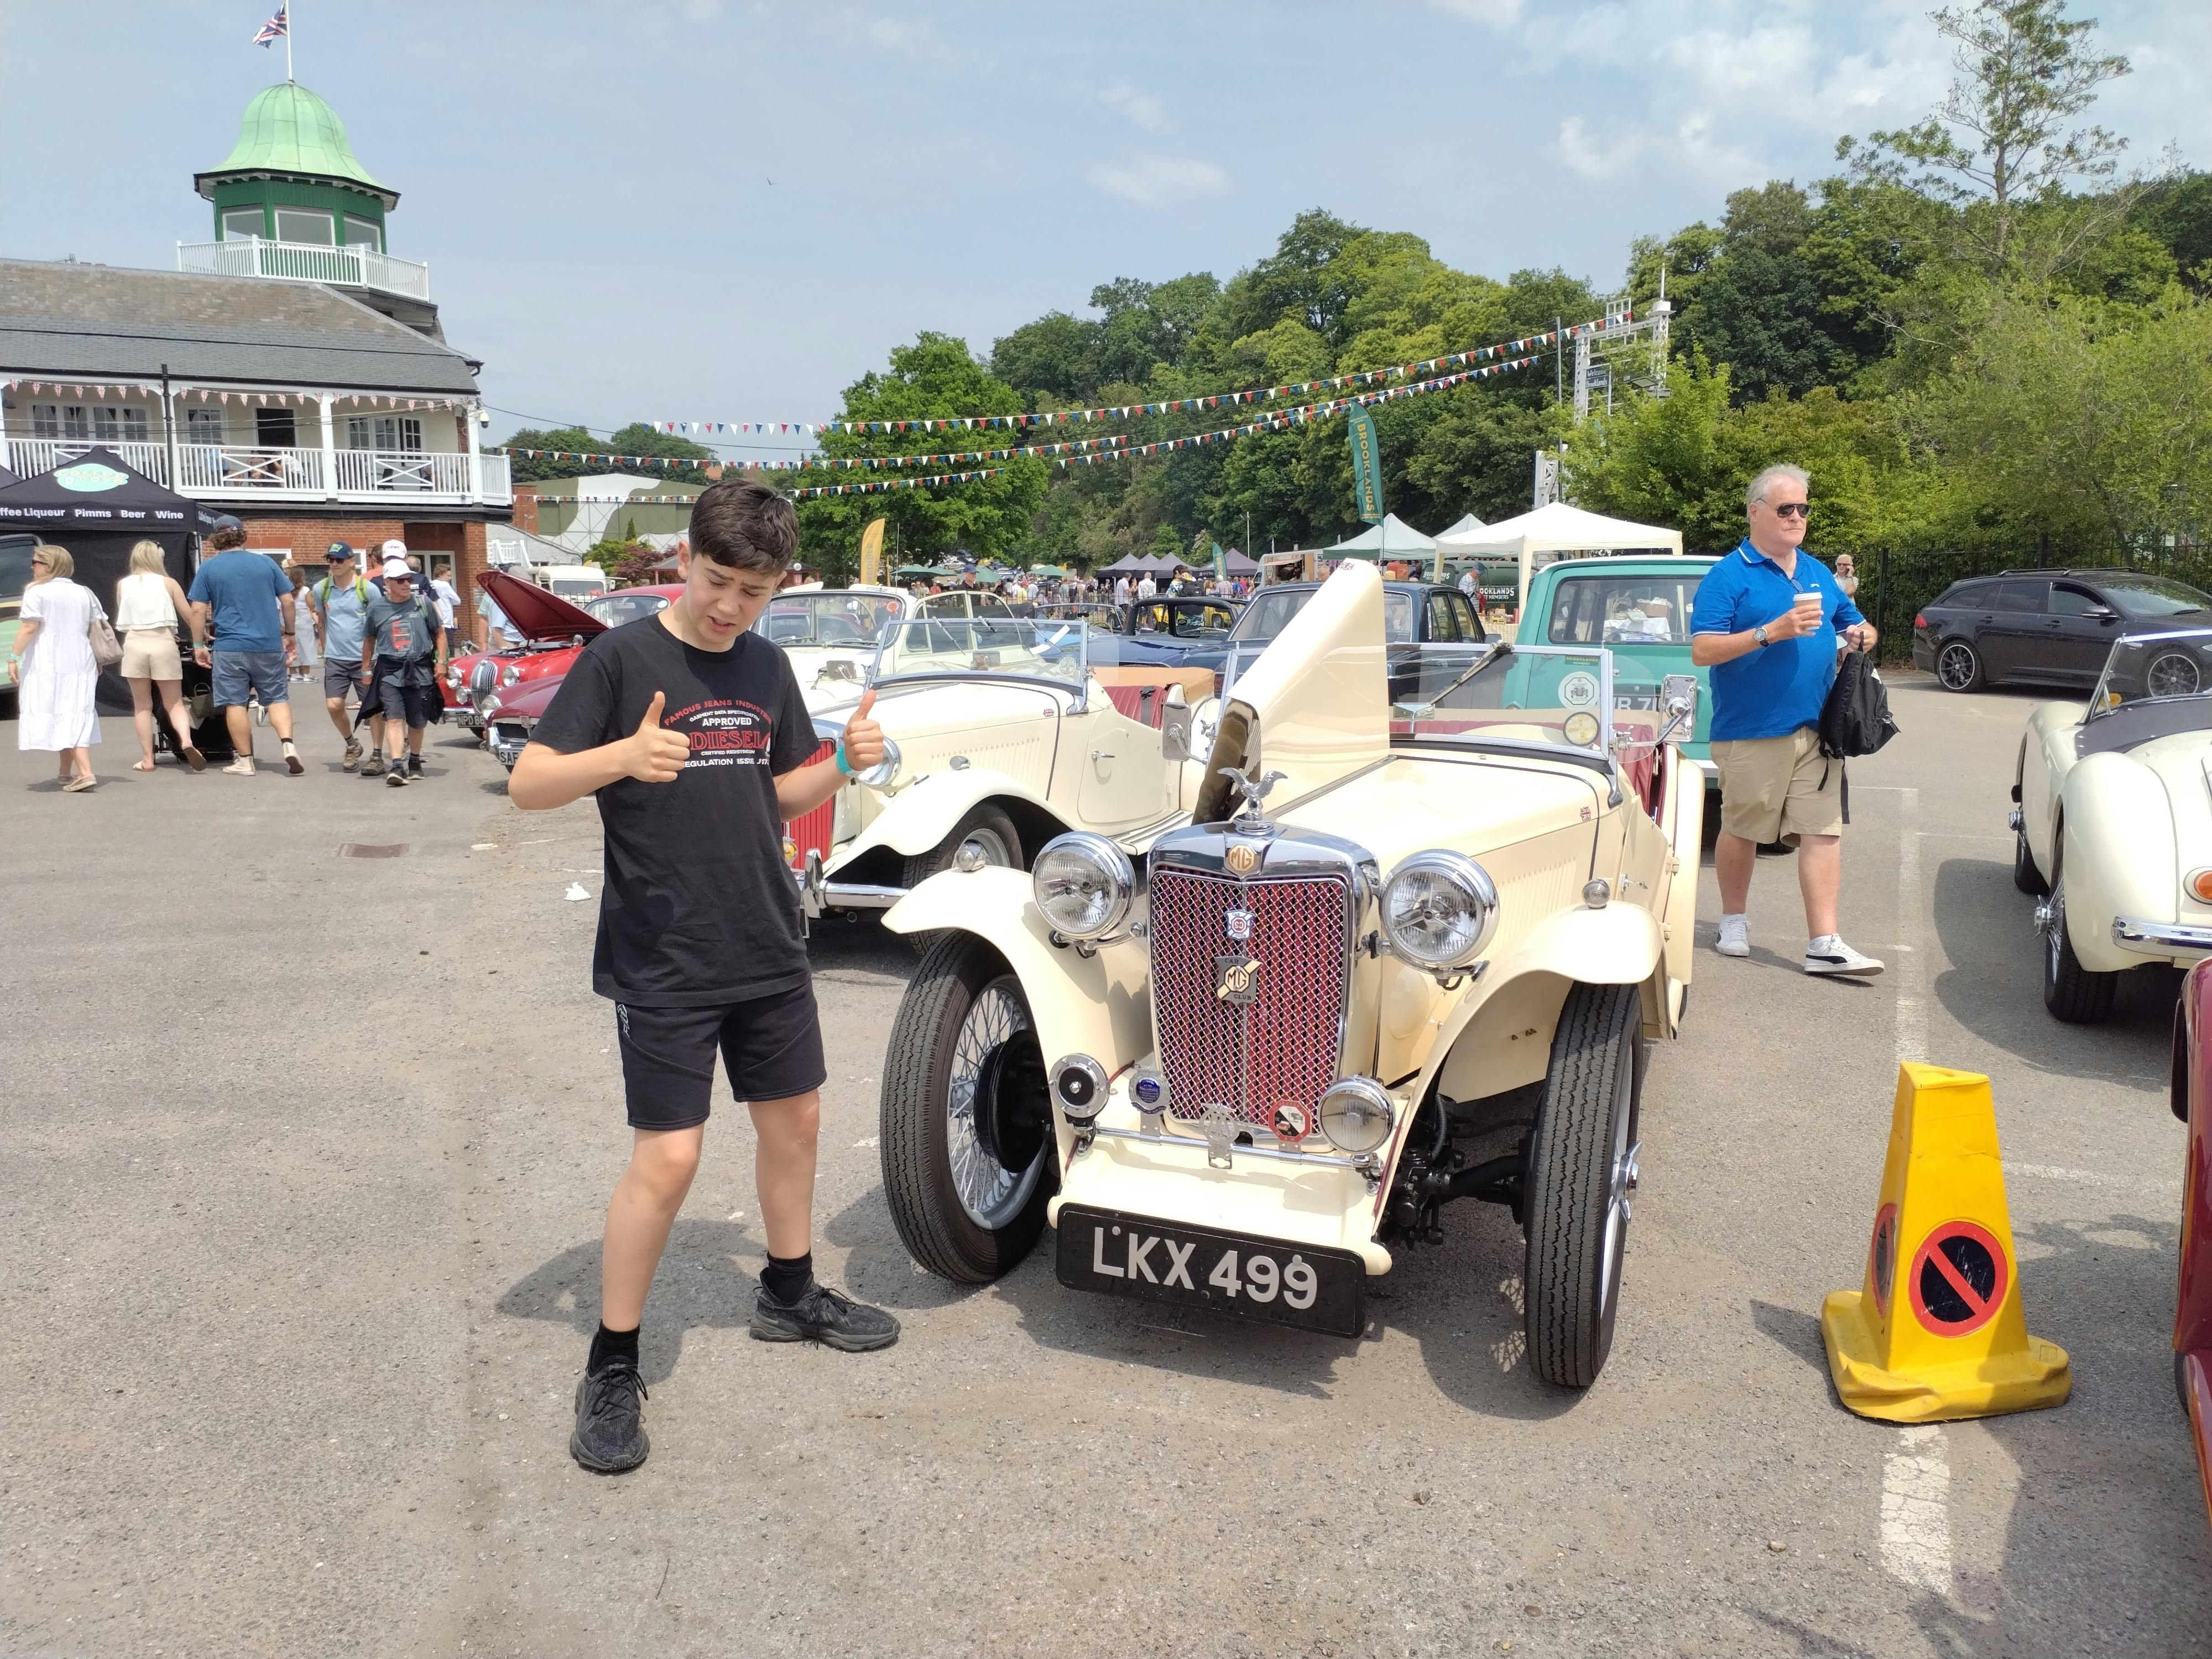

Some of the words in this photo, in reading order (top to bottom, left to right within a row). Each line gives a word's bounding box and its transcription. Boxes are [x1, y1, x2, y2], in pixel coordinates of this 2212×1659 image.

[1586, 377, 1608, 388] Brooklands
[1357, 423, 1375, 512] BROOKLANDS
[24, 508, 65, 518] Liqueur
[75, 508, 112, 518] Pimms
[121, 509, 146, 518] Beer
[155, 510, 184, 519] Wine
[1479, 587, 1515, 597] OOKLANDS
[664, 703, 702, 726] FAMOUS
[704, 700, 732, 708] JEANS
[736, 700, 773, 724] INDUSTRY
[690, 711, 714, 722] GARMENT
[457, 715, 474, 726] NPD
[702, 717, 752, 727] APPROVED
[690, 731, 771, 750] DIESEL
[684, 759, 733, 768] EGULATION
[1230, 847, 1253, 870] MG
[1227, 968, 1247, 989] MG
[1093, 1226, 1196, 1291] LKX
[1208, 1250, 1318, 1310] 499
